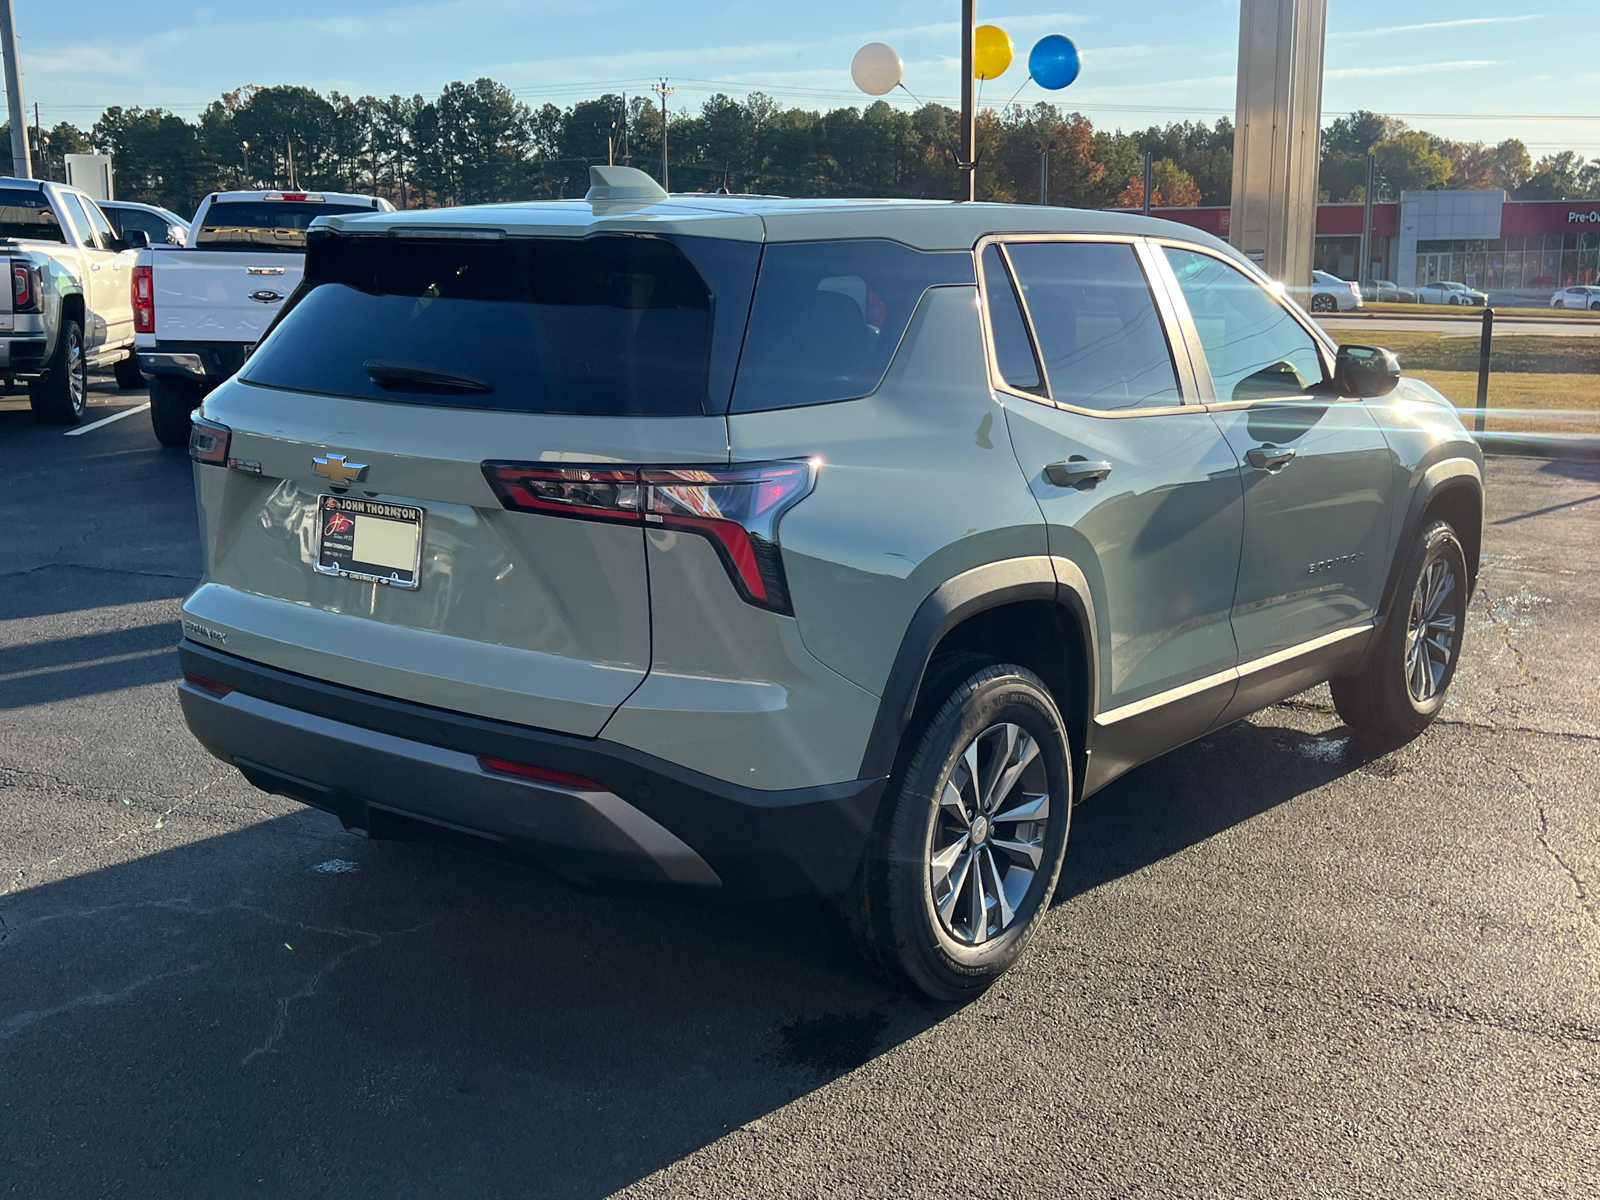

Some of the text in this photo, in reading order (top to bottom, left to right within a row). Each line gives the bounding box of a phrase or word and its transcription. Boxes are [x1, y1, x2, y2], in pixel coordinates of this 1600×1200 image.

[341, 499, 365, 512] JOHN
[366, 503, 416, 520] THORNTON
[349, 573, 378, 583] CHEVROLET
